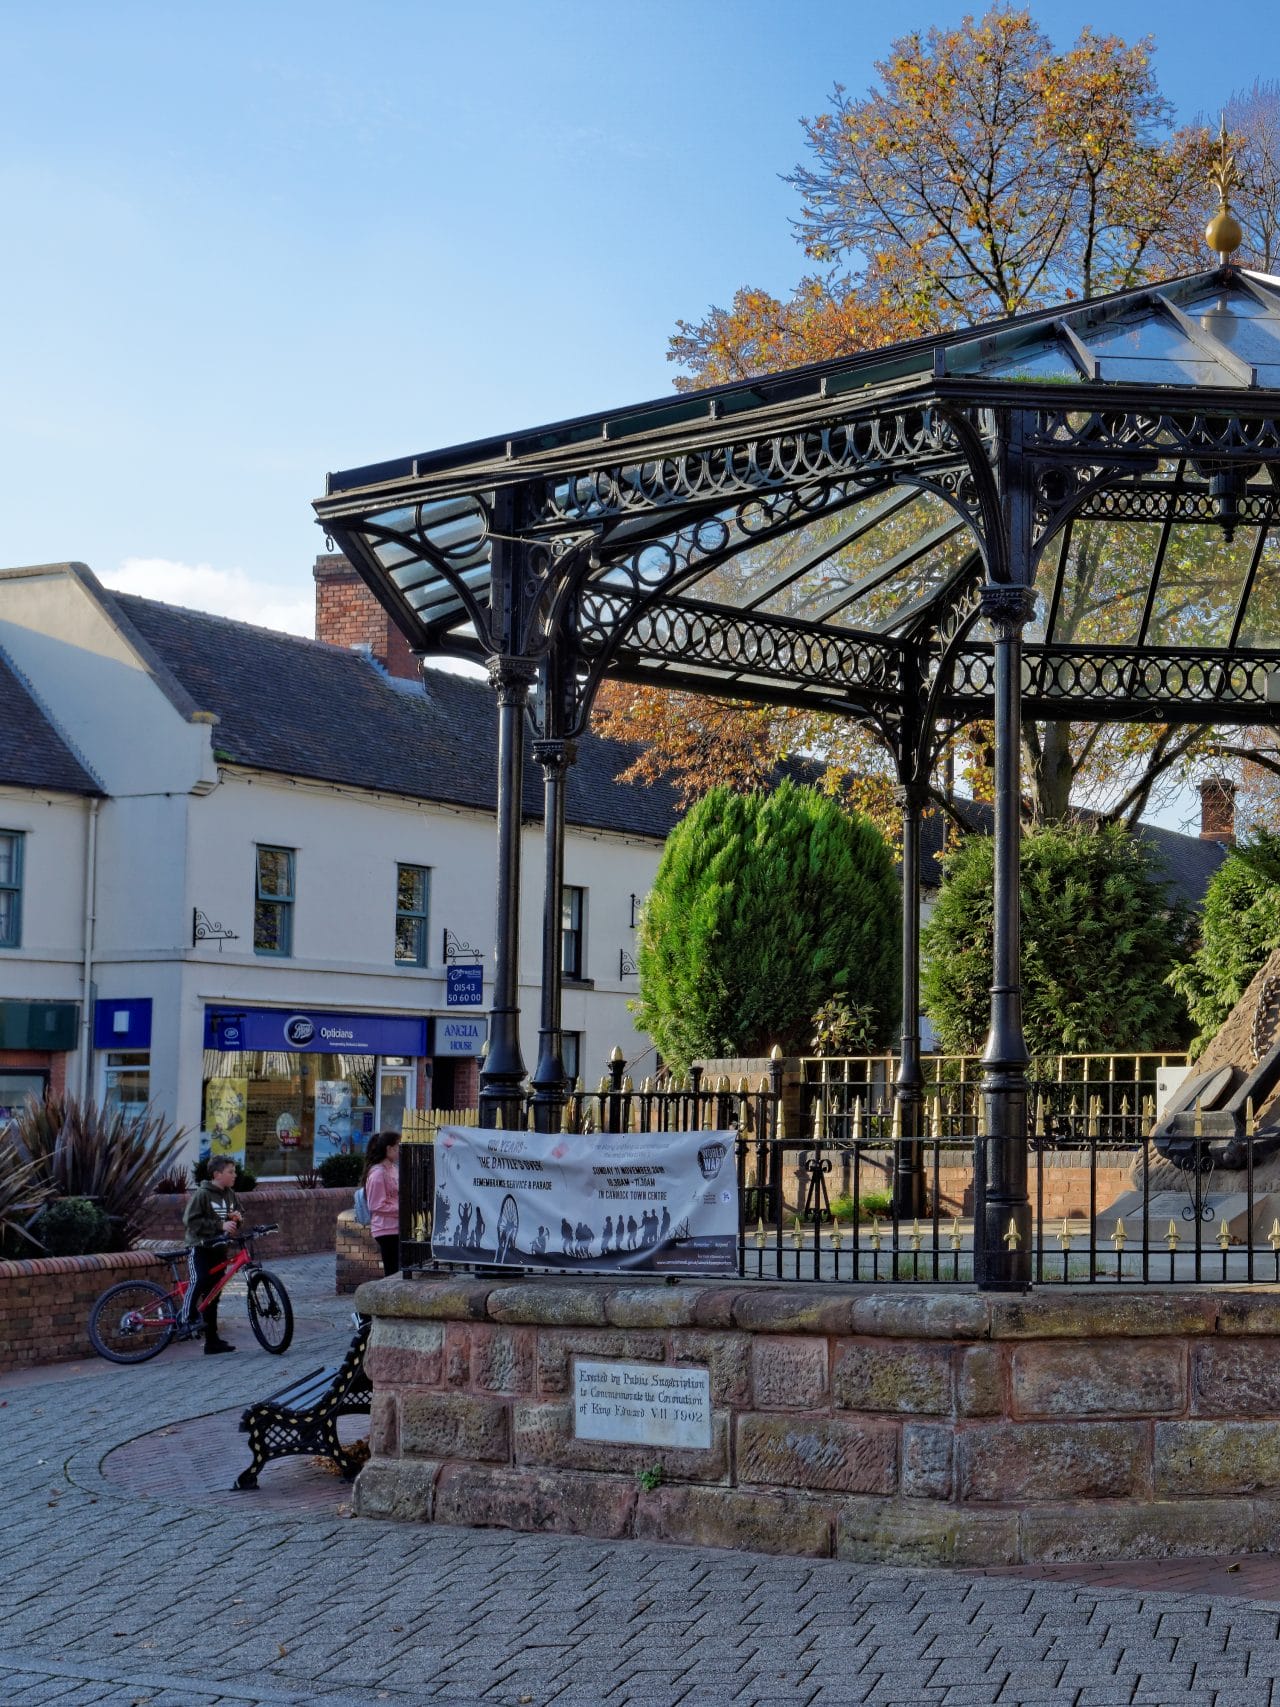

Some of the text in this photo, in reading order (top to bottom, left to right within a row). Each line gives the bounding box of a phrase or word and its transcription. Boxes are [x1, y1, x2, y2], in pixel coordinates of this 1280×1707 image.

[453, 983, 476, 992] 01543
[448, 993, 481, 1002] 50 60 00
[320, 1027, 353, 1039] Opticians
[444, 1024, 479, 1037] ANGLIA
[450, 1041, 473, 1050] HOUSE
[477, 1156, 491, 1169] THE
[592, 1166, 614, 1175] SUNDAY
[614, 1166, 620, 1175] 11
[620, 1166, 651, 1175] NOVEMBER
[506, 1179, 528, 1190] SERVICE
[532, 1181, 552, 1191] PARADE
[598, 1190, 667, 1201] IN CANNOCK TOWN CENTRE
[580, 1369, 608, 1383] Erected
[611, 1373, 621, 1385] by
[623, 1373, 649, 1386] Public
[580, 1387, 588, 1397] to
[644, 1392, 655, 1402] the
[658, 1391, 703, 1406] Coronation
[580, 1402, 703, 1423] of King Edward VII 1902
